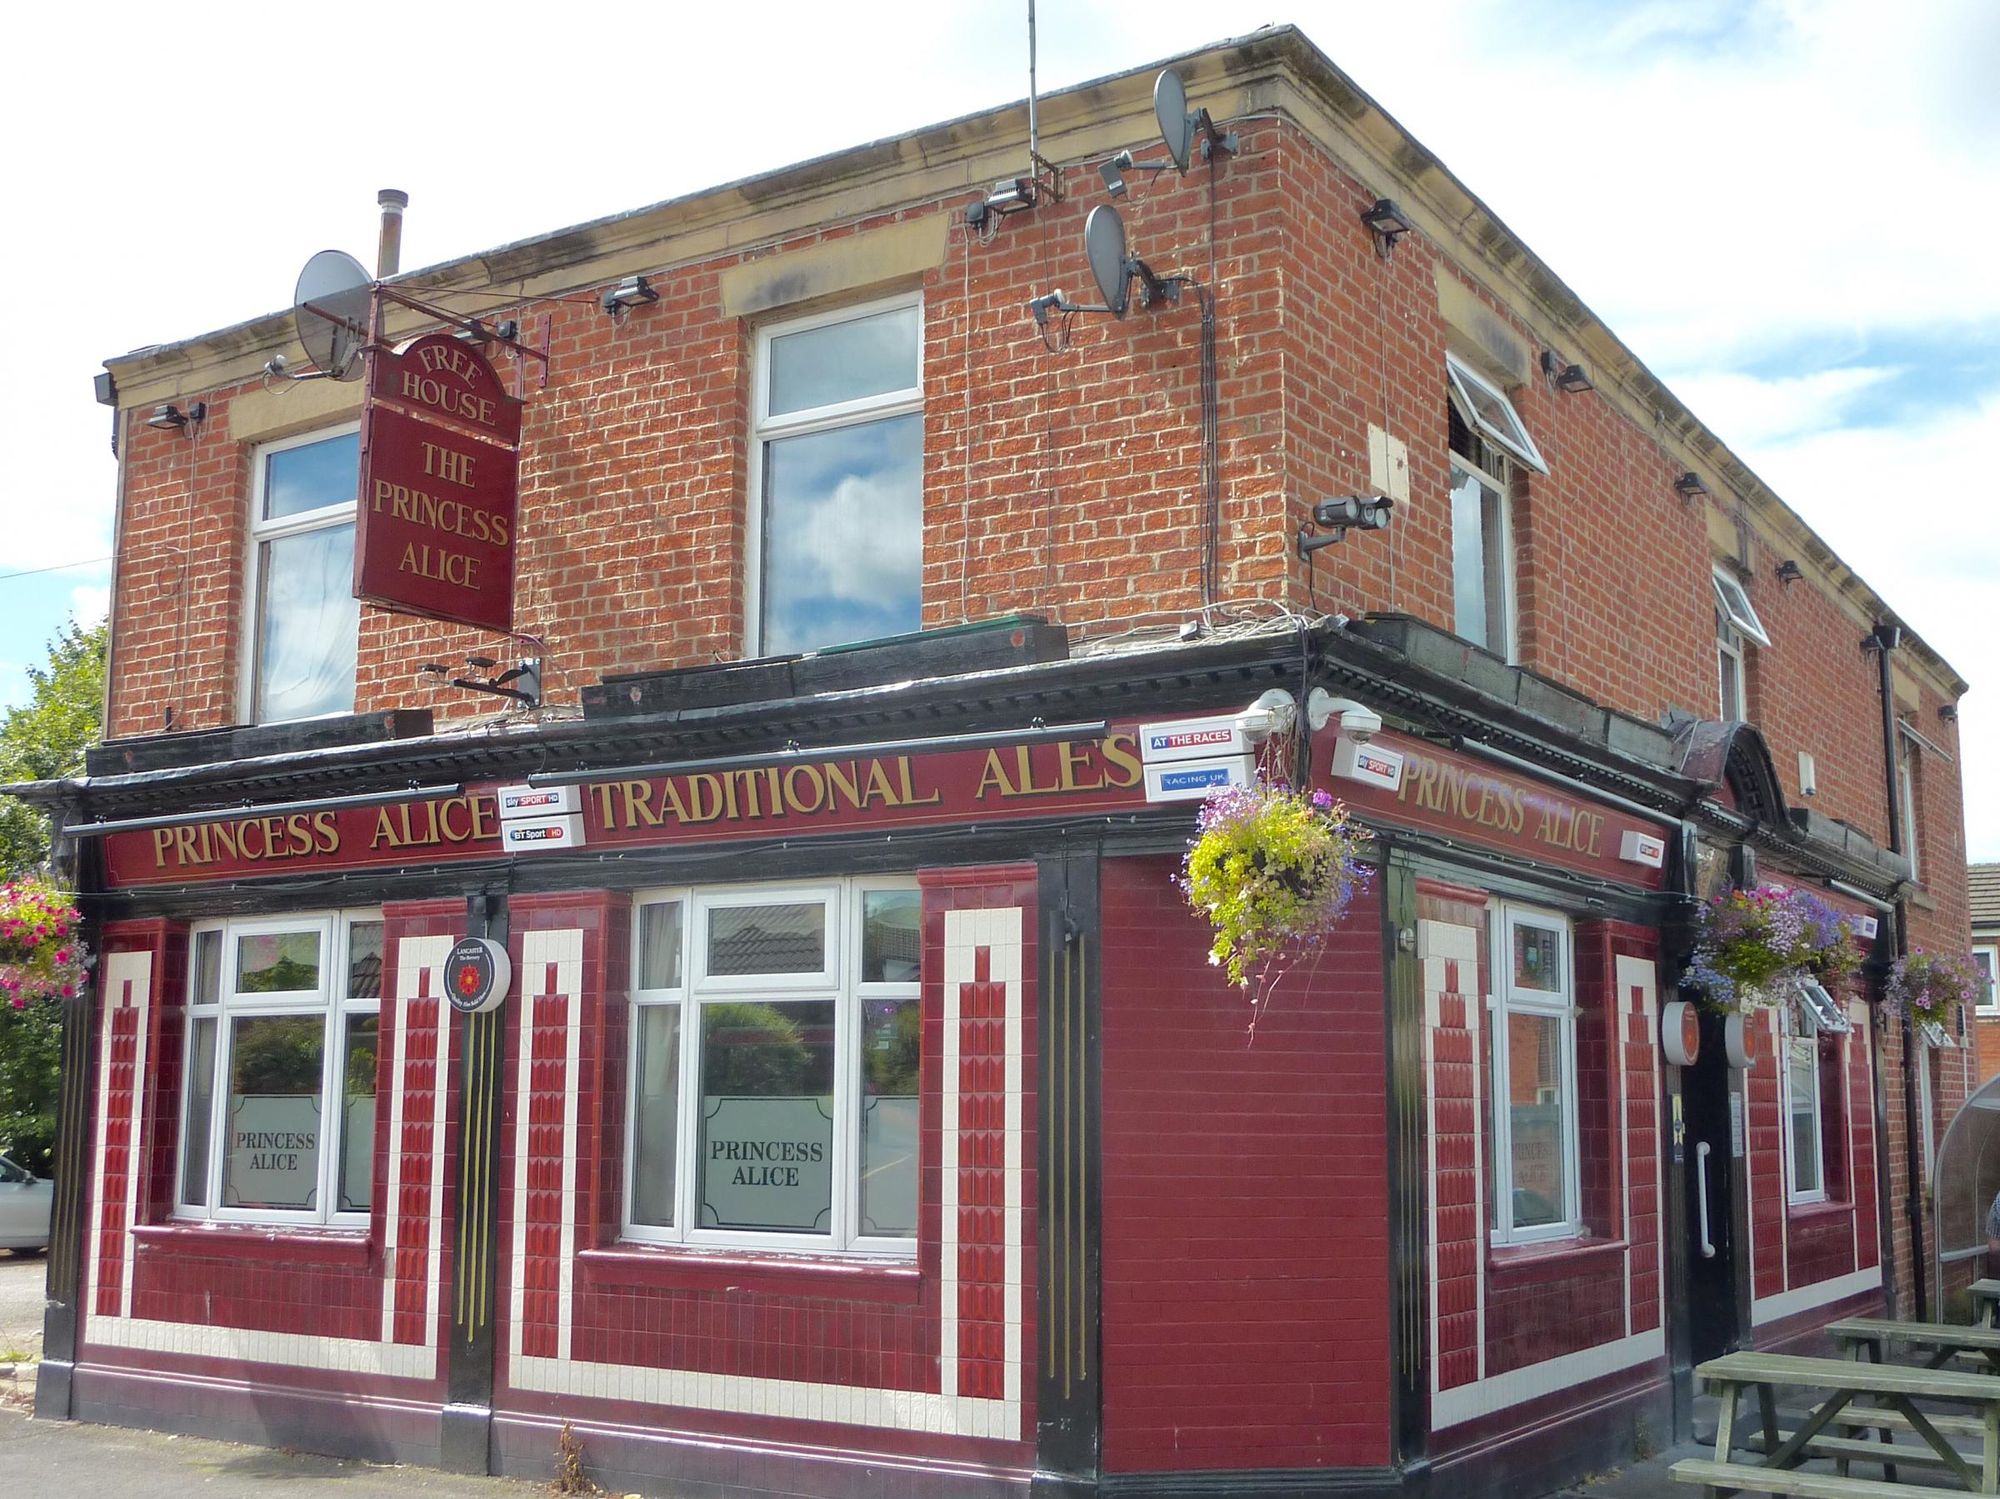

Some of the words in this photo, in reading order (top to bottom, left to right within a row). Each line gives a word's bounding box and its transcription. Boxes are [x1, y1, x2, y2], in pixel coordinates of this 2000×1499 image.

[416, 345, 482, 389] FREE
[402, 370, 496, 426] HOUSE
[422, 441, 476, 488] THE
[373, 478, 509, 546] PRINCESS
[398, 541, 481, 590] ALICE
[1154, 738, 1167, 747] AT
[1170, 735, 1191, 746] THE
[1193, 732, 1230, 743] RACES
[1368, 759, 1388, 774] SPORT
[1165, 775, 1206, 785] RACING
[153, 810, 340, 867] PRINCESS
[369, 795, 499, 848] ALICE
[589, 755, 940, 830] TRADITIONAL
[975, 732, 1144, 799] ALES
[520, 795, 546, 805] SPORT
[548, 794, 558, 802] HD
[1397, 751, 1527, 835] PRINCESS
[1534, 798, 1605, 858] ALICE
[526, 830, 545, 840] Sport
[236, 1132, 316, 1150] PRINCESS
[711, 1140, 824, 1163] PRINCESS
[249, 1153, 298, 1171] ALICE
[731, 1165, 800, 1187] ALICE
